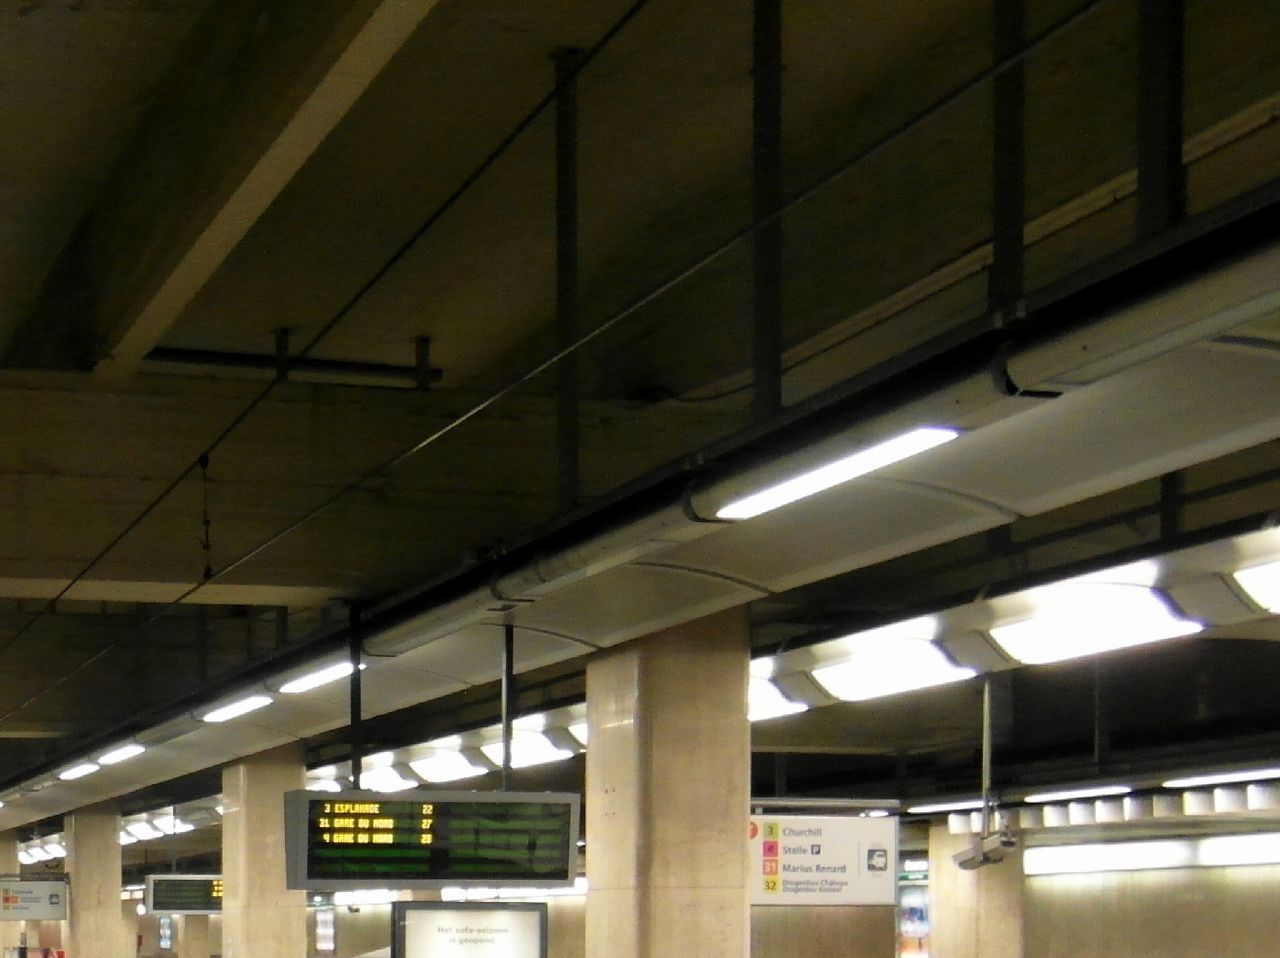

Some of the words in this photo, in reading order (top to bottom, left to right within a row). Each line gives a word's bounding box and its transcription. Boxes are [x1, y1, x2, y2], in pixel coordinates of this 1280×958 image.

[324, 803, 331, 814] 3
[334, 803, 380, 814] ESPLANADE
[422, 804, 434, 815] 22
[319, 818, 330, 828] 31
[333, 818, 355, 828] GARE
[358, 818, 370, 829] DU
[373, 818, 394, 829] NORD
[421, 819, 433, 829] 27
[767, 825, 774, 836] 3
[782, 827, 823, 837] Churchill
[333, 833, 355, 843] GARE
[357, 833, 369, 844] DU
[372, 833, 394, 844] NORD
[782, 845, 809, 855] Stalle
[782, 864, 813, 873] Marius
[815, 864, 847, 873] Renard
[764, 881, 777, 891] 32
